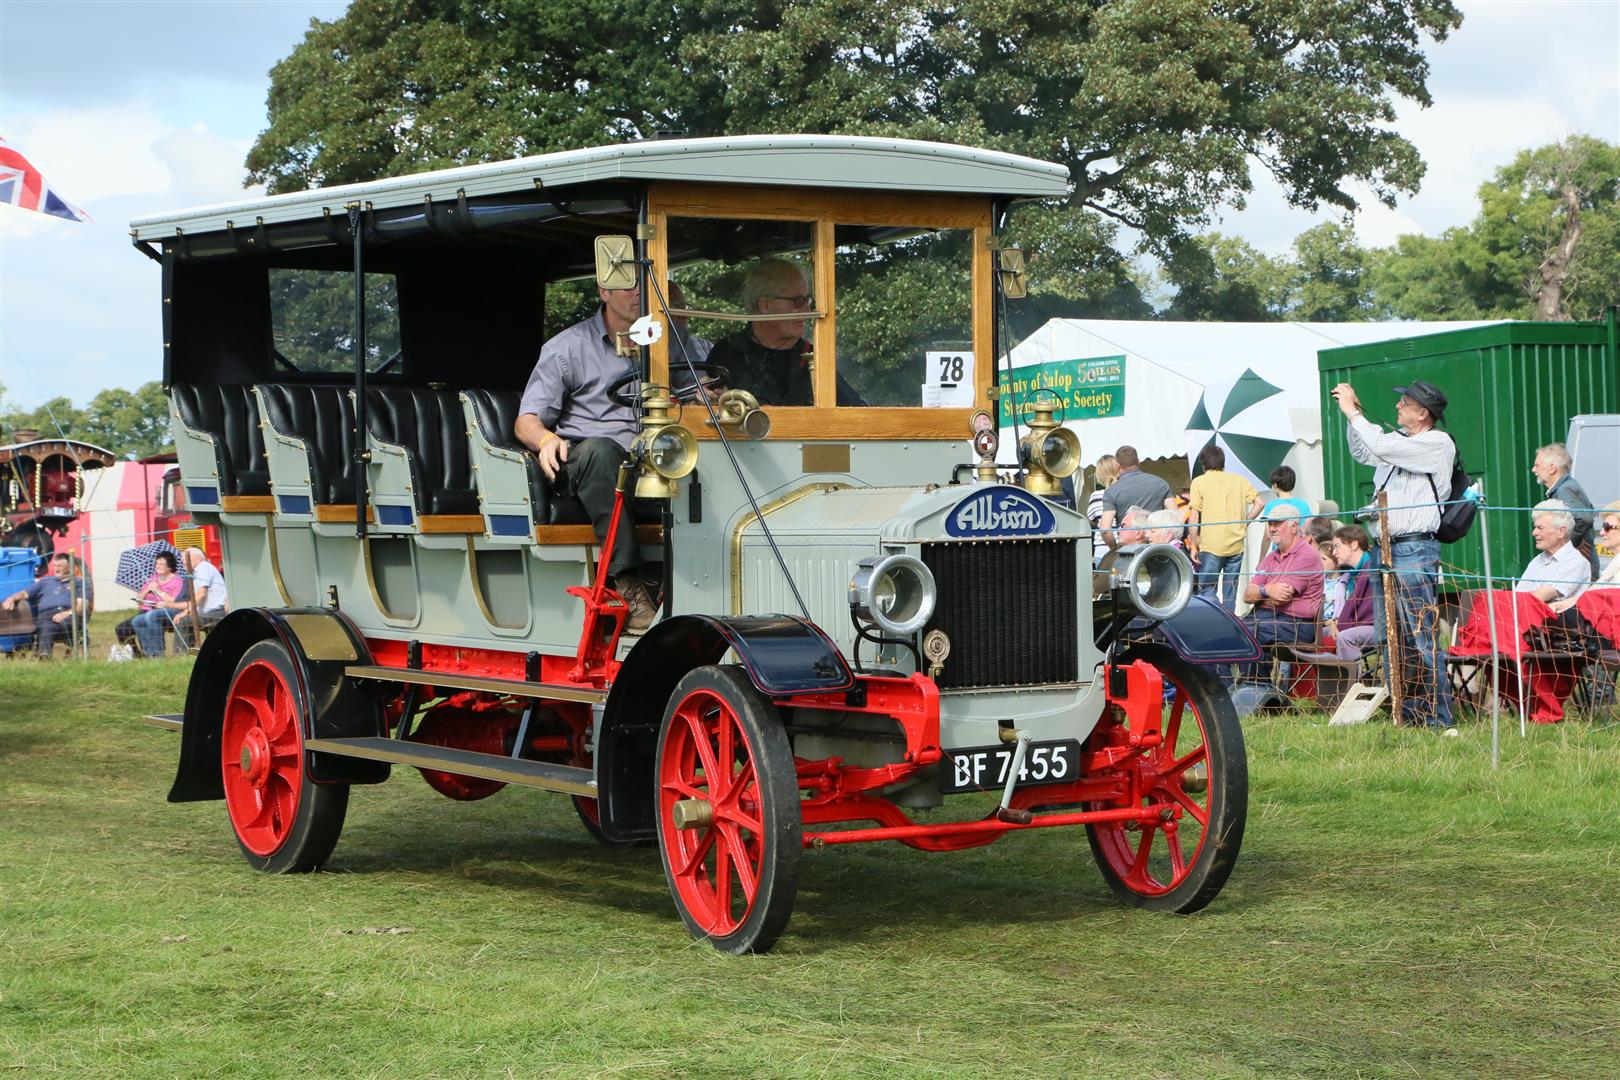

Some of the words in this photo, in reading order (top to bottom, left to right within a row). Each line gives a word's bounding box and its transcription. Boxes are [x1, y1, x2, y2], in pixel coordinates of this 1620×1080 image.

[940, 356, 964, 382] 78
[1095, 365, 1121, 376] YEARS
[999, 379, 1028, 397] ounty
[1031, 372, 1041, 391] of
[1043, 369, 1073, 392] Salop
[1073, 389, 1113, 414] Society
[957, 494, 1042, 531] Albion
[954, 753, 987, 787] BF
